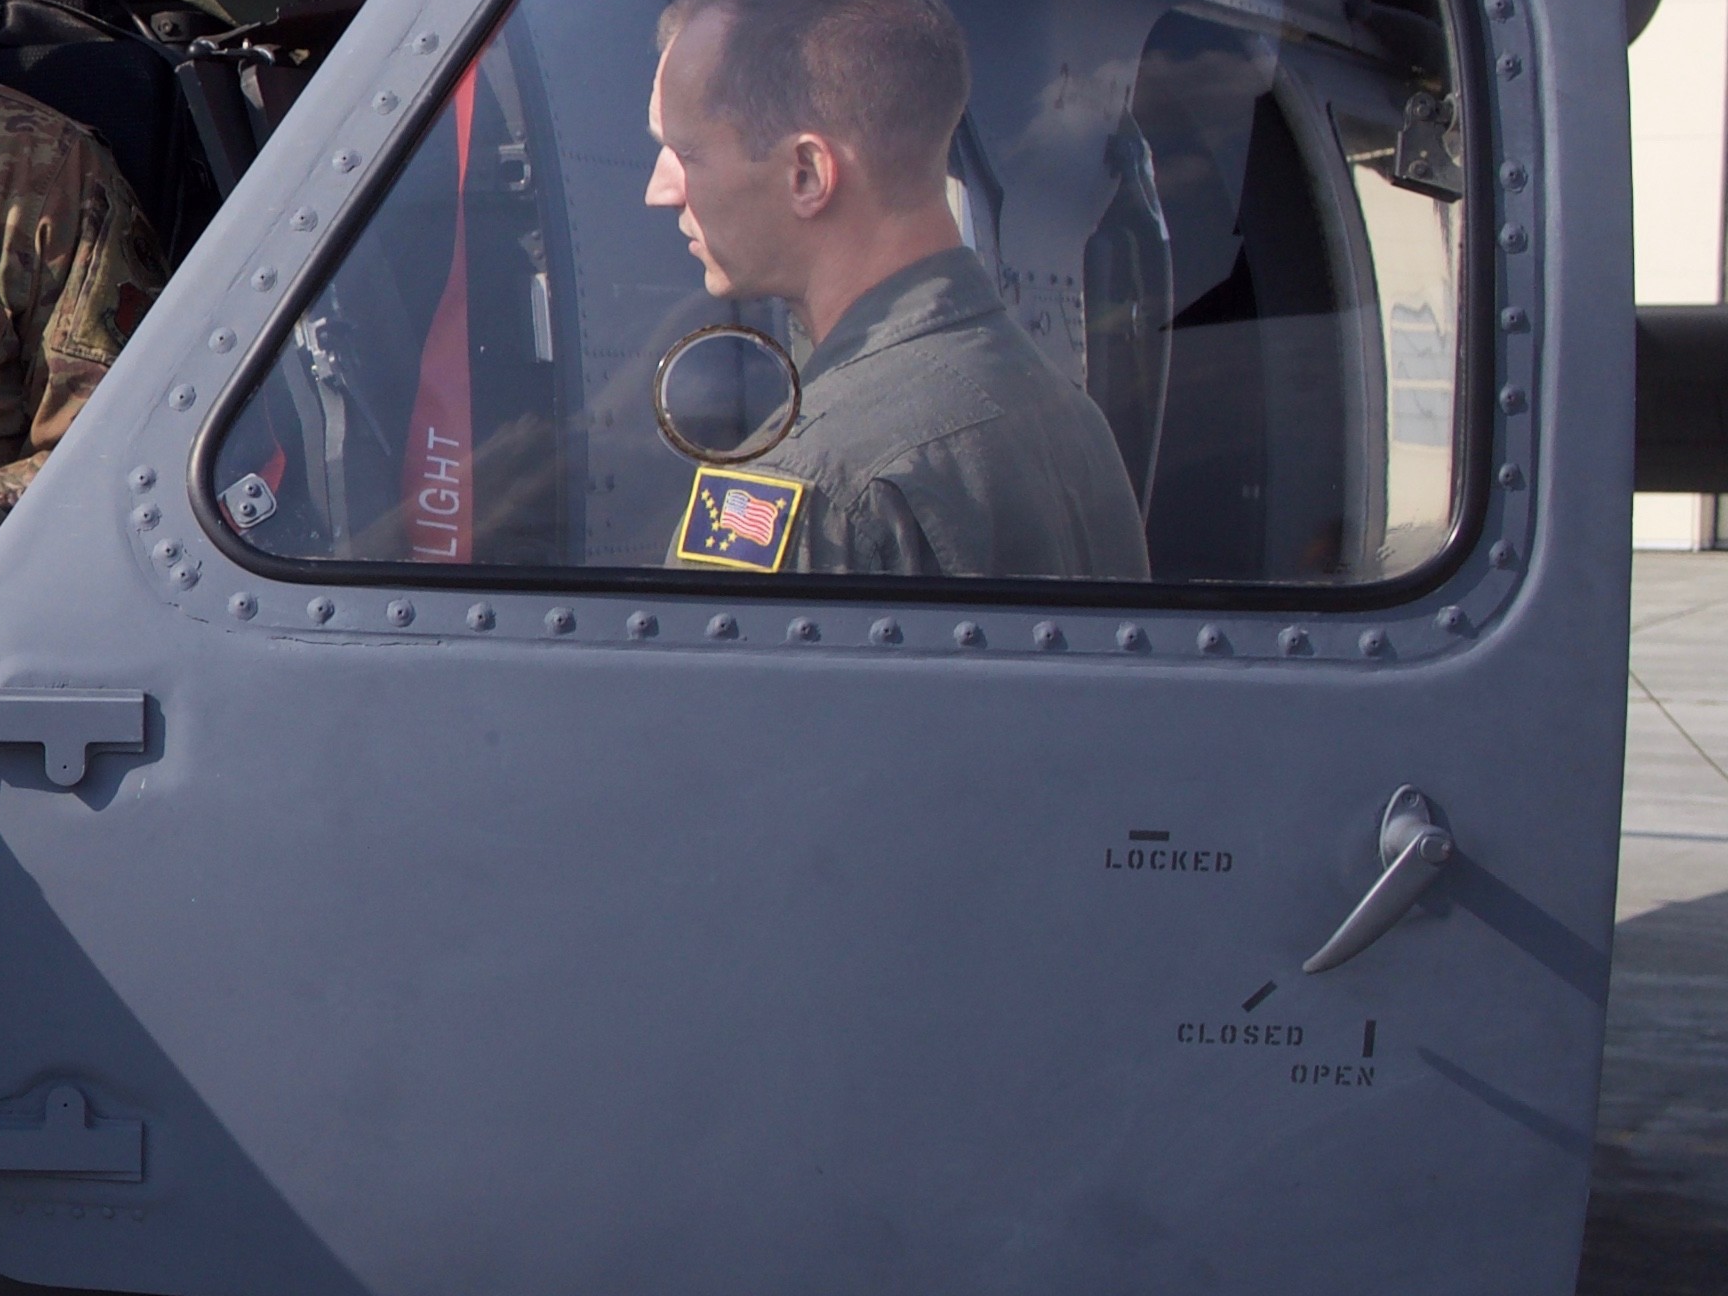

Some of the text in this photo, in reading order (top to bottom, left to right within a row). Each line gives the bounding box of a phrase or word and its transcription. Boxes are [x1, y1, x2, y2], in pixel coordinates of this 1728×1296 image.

[412, 426, 460, 561] LIGHT
[1104, 848, 1234, 873] LOCKED
[1177, 1022, 1305, 1047] CLOSED
[1289, 1064, 1376, 1087] OPEN
